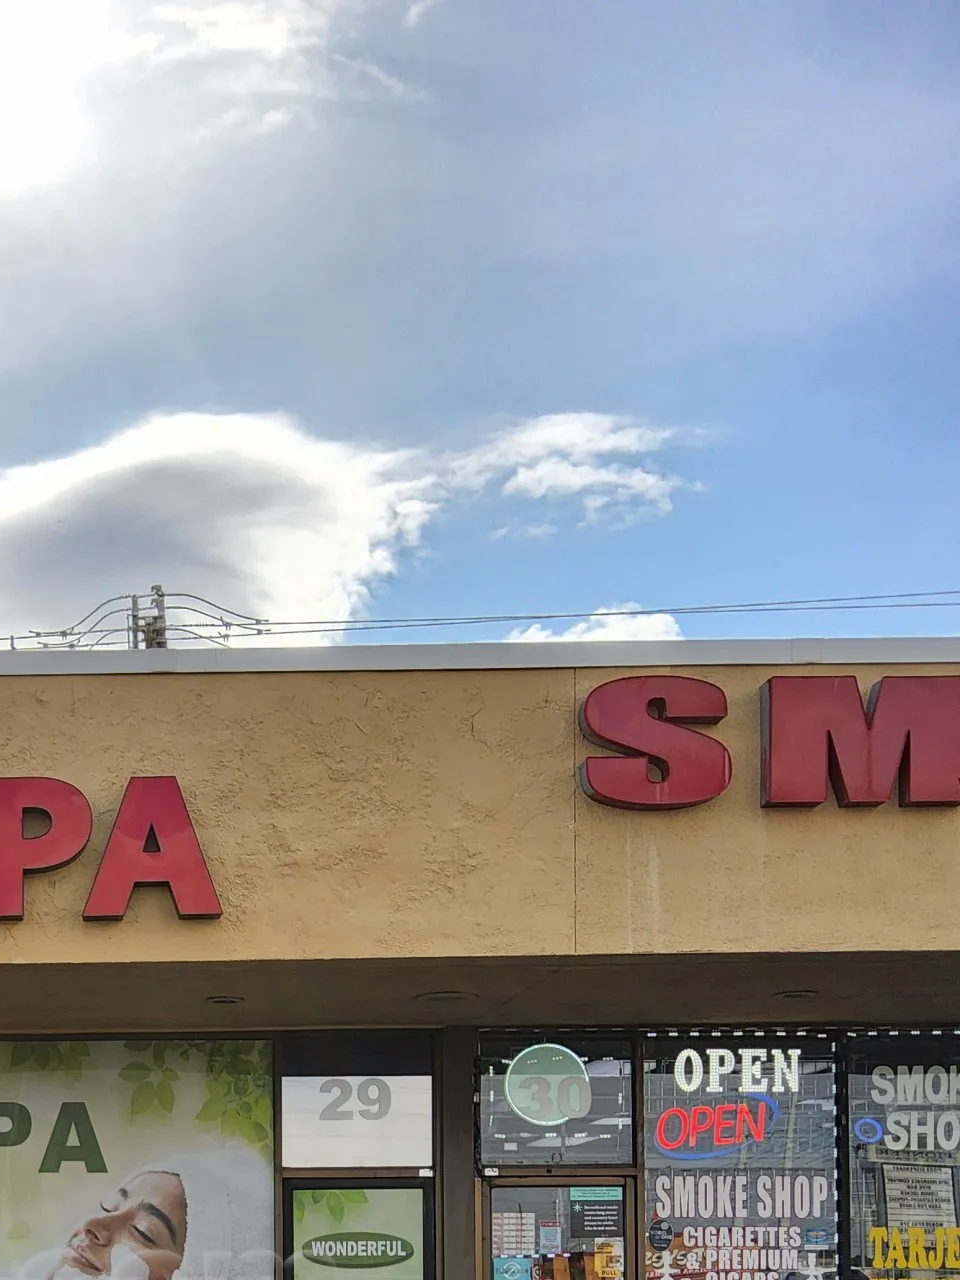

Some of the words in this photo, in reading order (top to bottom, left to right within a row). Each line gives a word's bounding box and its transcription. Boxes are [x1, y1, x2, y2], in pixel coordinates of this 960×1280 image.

[674, 1048, 801, 1093] OPEN
[318, 1077, 392, 1121] 29
[518, 1076, 592, 1119] 30
[656, 1102, 766, 1149] OPEN
[655, 1175, 748, 1218] SMOKE
[756, 1175, 828, 1218] SHOP
[311, 1241, 406, 1257] WONDERFUL
[683, 1226, 801, 1247] CIGARETTES
[686, 1252, 700, 1269] &
[705, 1249, 798, 1270] PREMIUM
